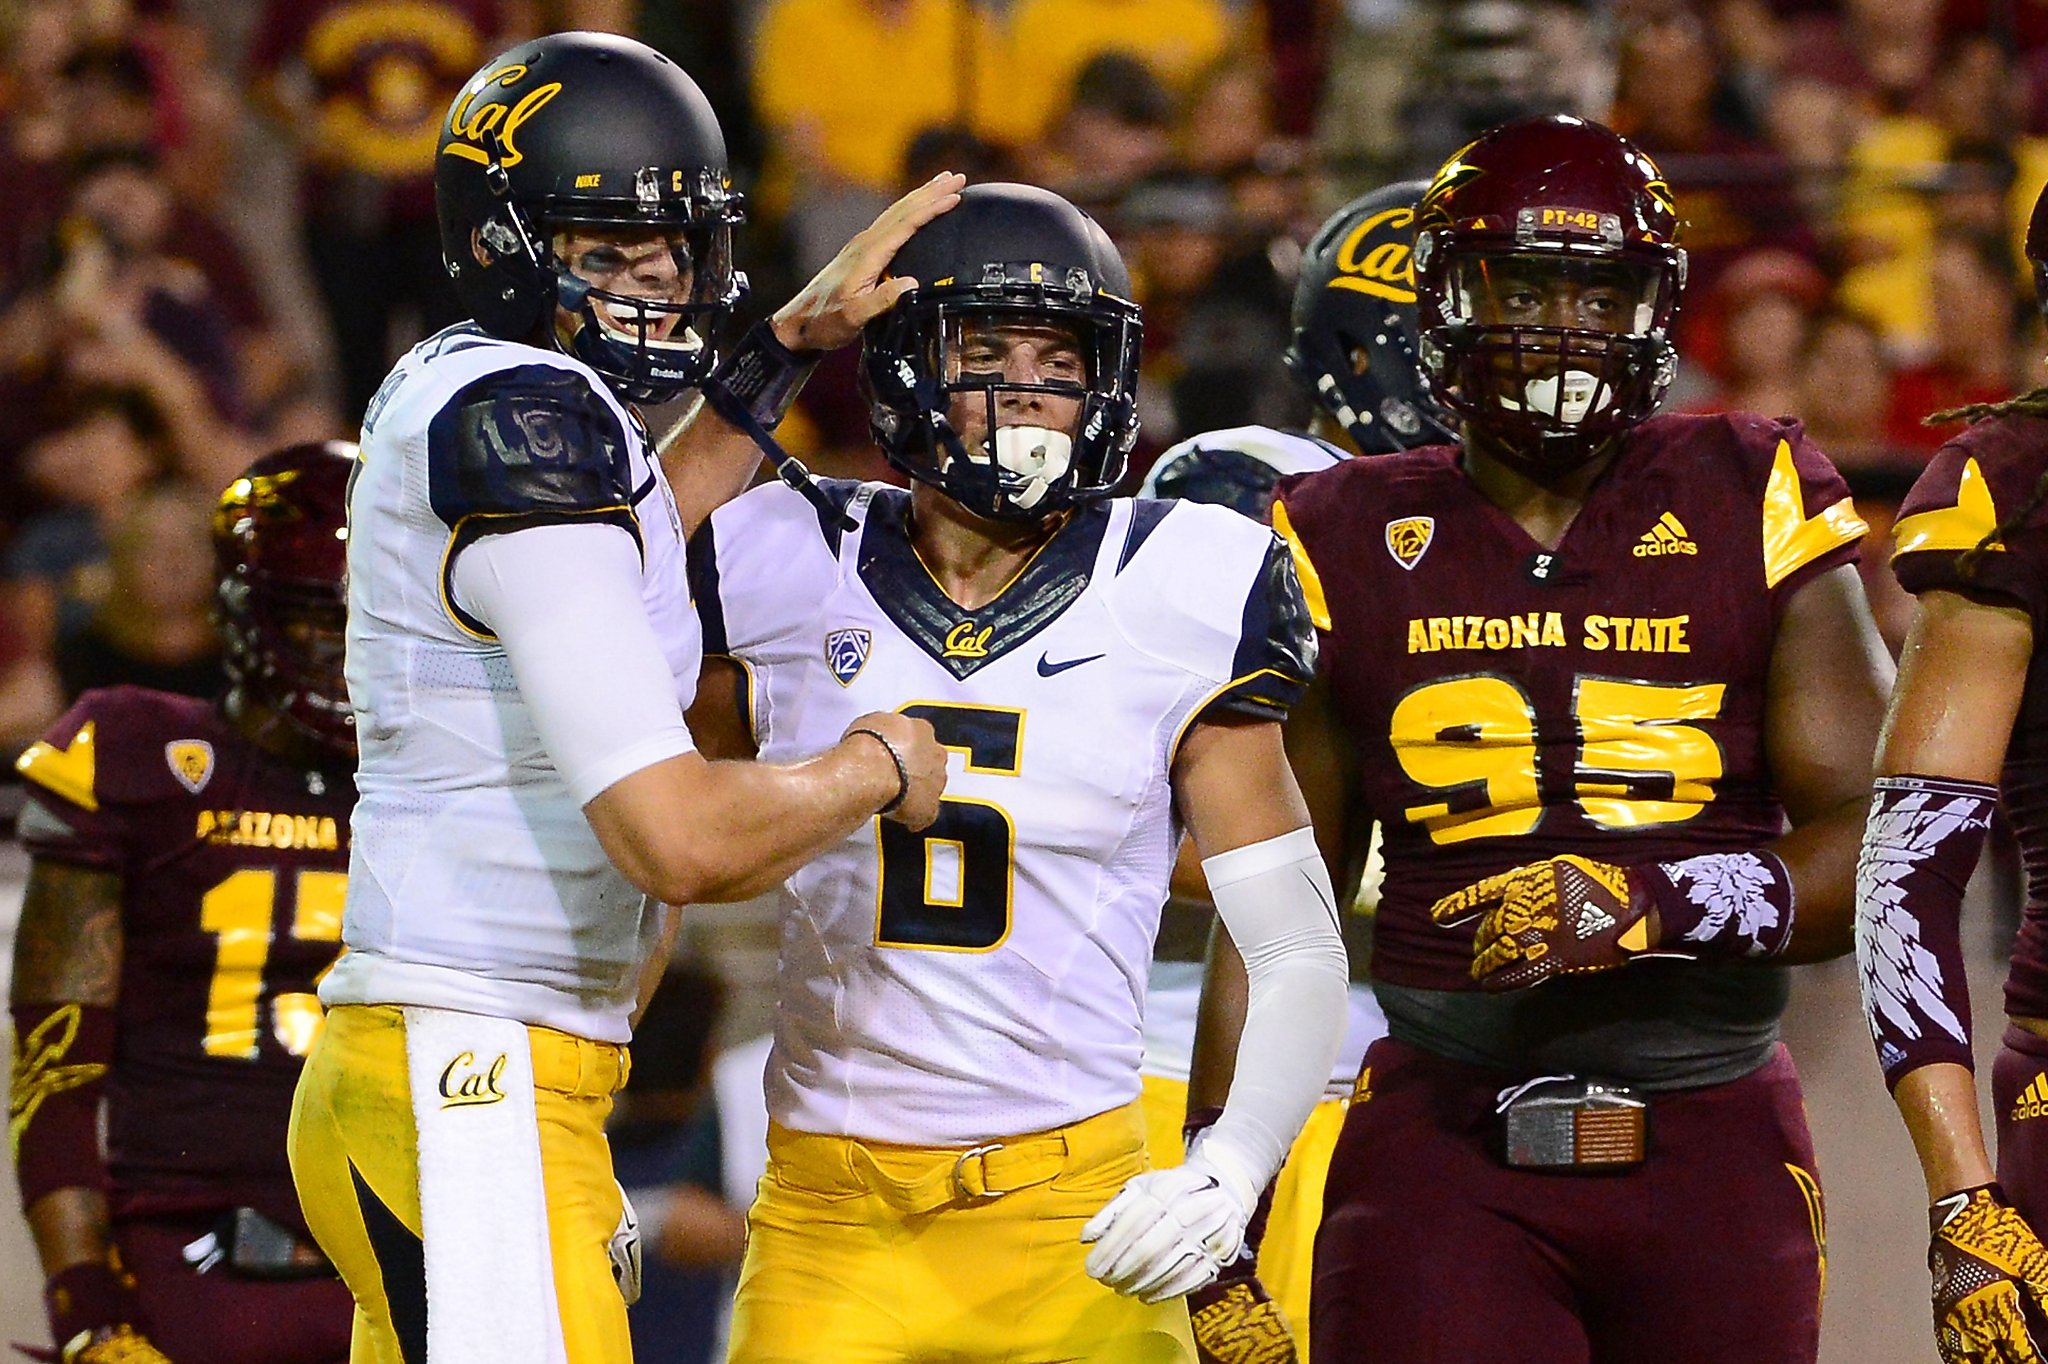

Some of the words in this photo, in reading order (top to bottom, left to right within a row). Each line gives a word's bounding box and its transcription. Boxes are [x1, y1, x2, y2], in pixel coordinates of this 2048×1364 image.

[442, 64, 563, 168] Cal
[574, 174, 602, 189] NIKE
[1030, 263, 1043, 283] C
[1389, 520, 1431, 549] PAC
[1398, 537, 1420, 558] 12
[1633, 538, 1698, 557] adidas
[829, 630, 871, 663] PAC
[943, 622, 994, 658] Cal
[1408, 612, 1567, 654] ARIZONA
[1583, 614, 1691, 653] STATE
[836, 652, 858, 674] 12
[1388, 671, 1728, 846] 95
[873, 699, 1028, 954] 6
[438, 1050, 507, 1110] Cal
